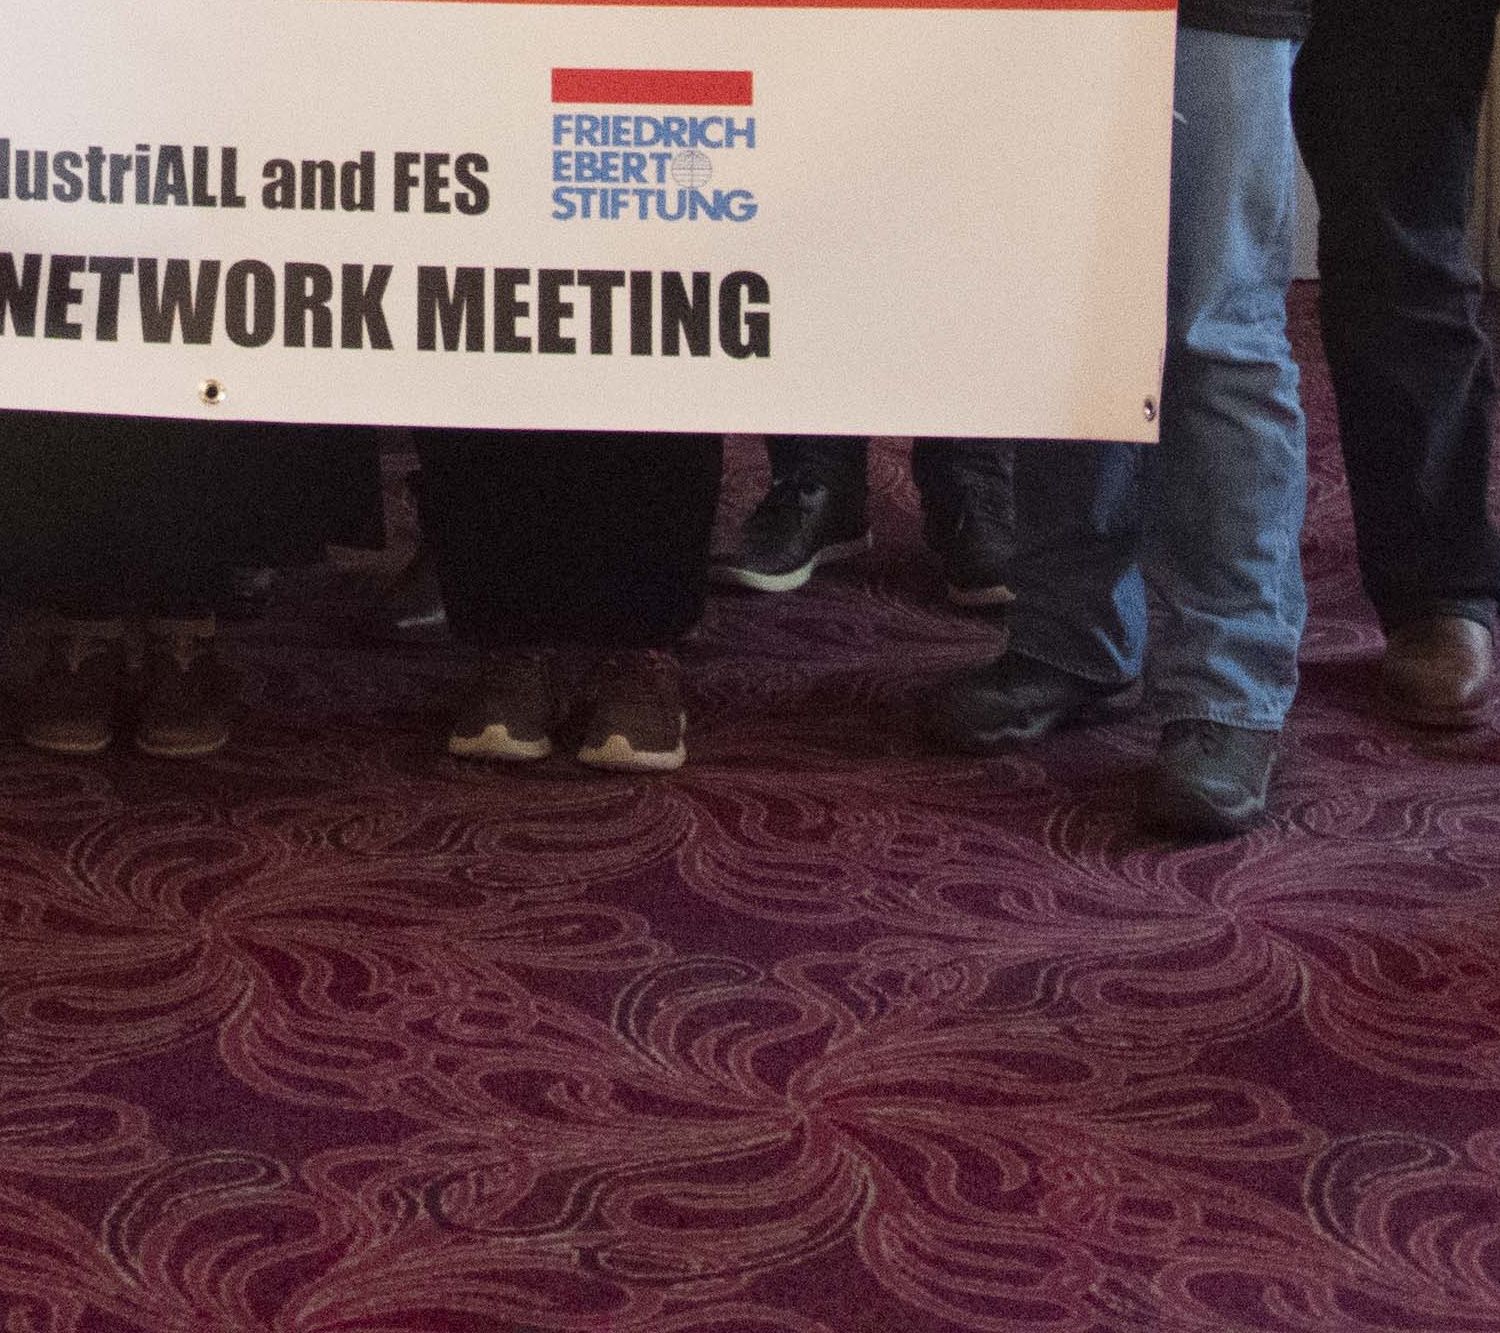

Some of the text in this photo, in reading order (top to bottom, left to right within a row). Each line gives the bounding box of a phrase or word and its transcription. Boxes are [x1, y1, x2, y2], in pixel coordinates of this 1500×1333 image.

[552, 114, 756, 149] FRIEDRICH
[262, 151, 376, 212] and
[394, 151, 490, 215] FES
[552, 150, 672, 184] EBERT
[551, 186, 758, 222] STIFTUNG
[417, 265, 771, 359] MEETING
